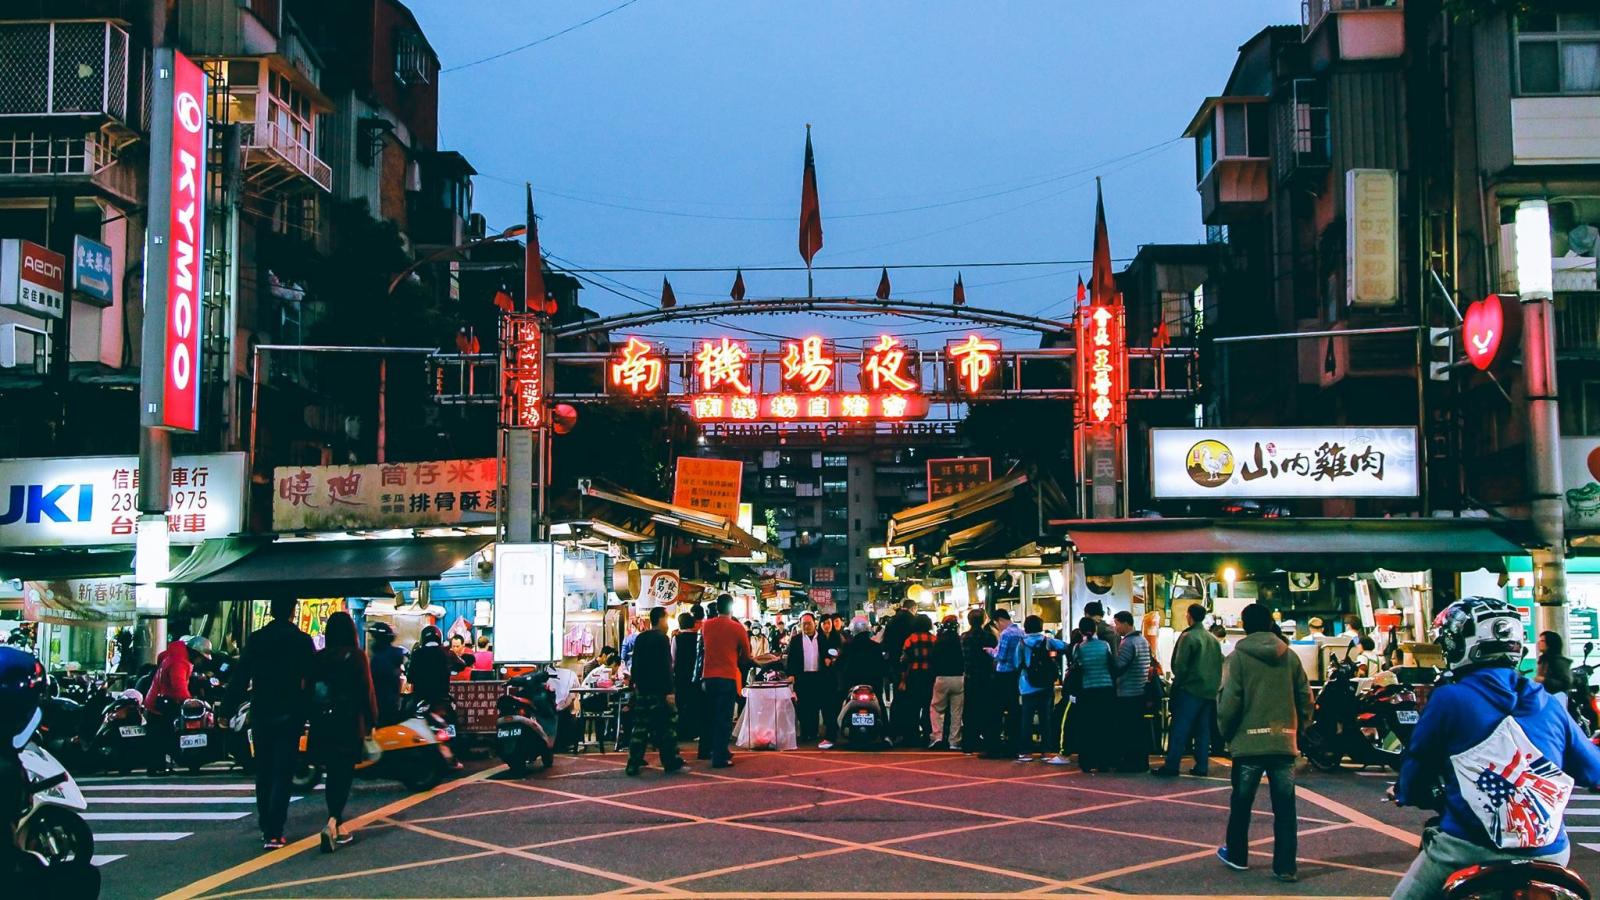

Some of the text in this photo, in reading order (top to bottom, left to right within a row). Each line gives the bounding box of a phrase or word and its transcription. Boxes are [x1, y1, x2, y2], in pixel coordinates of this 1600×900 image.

[173, 149, 197, 390] KYMCO
[612, 334, 999, 394] 南機場夜市
